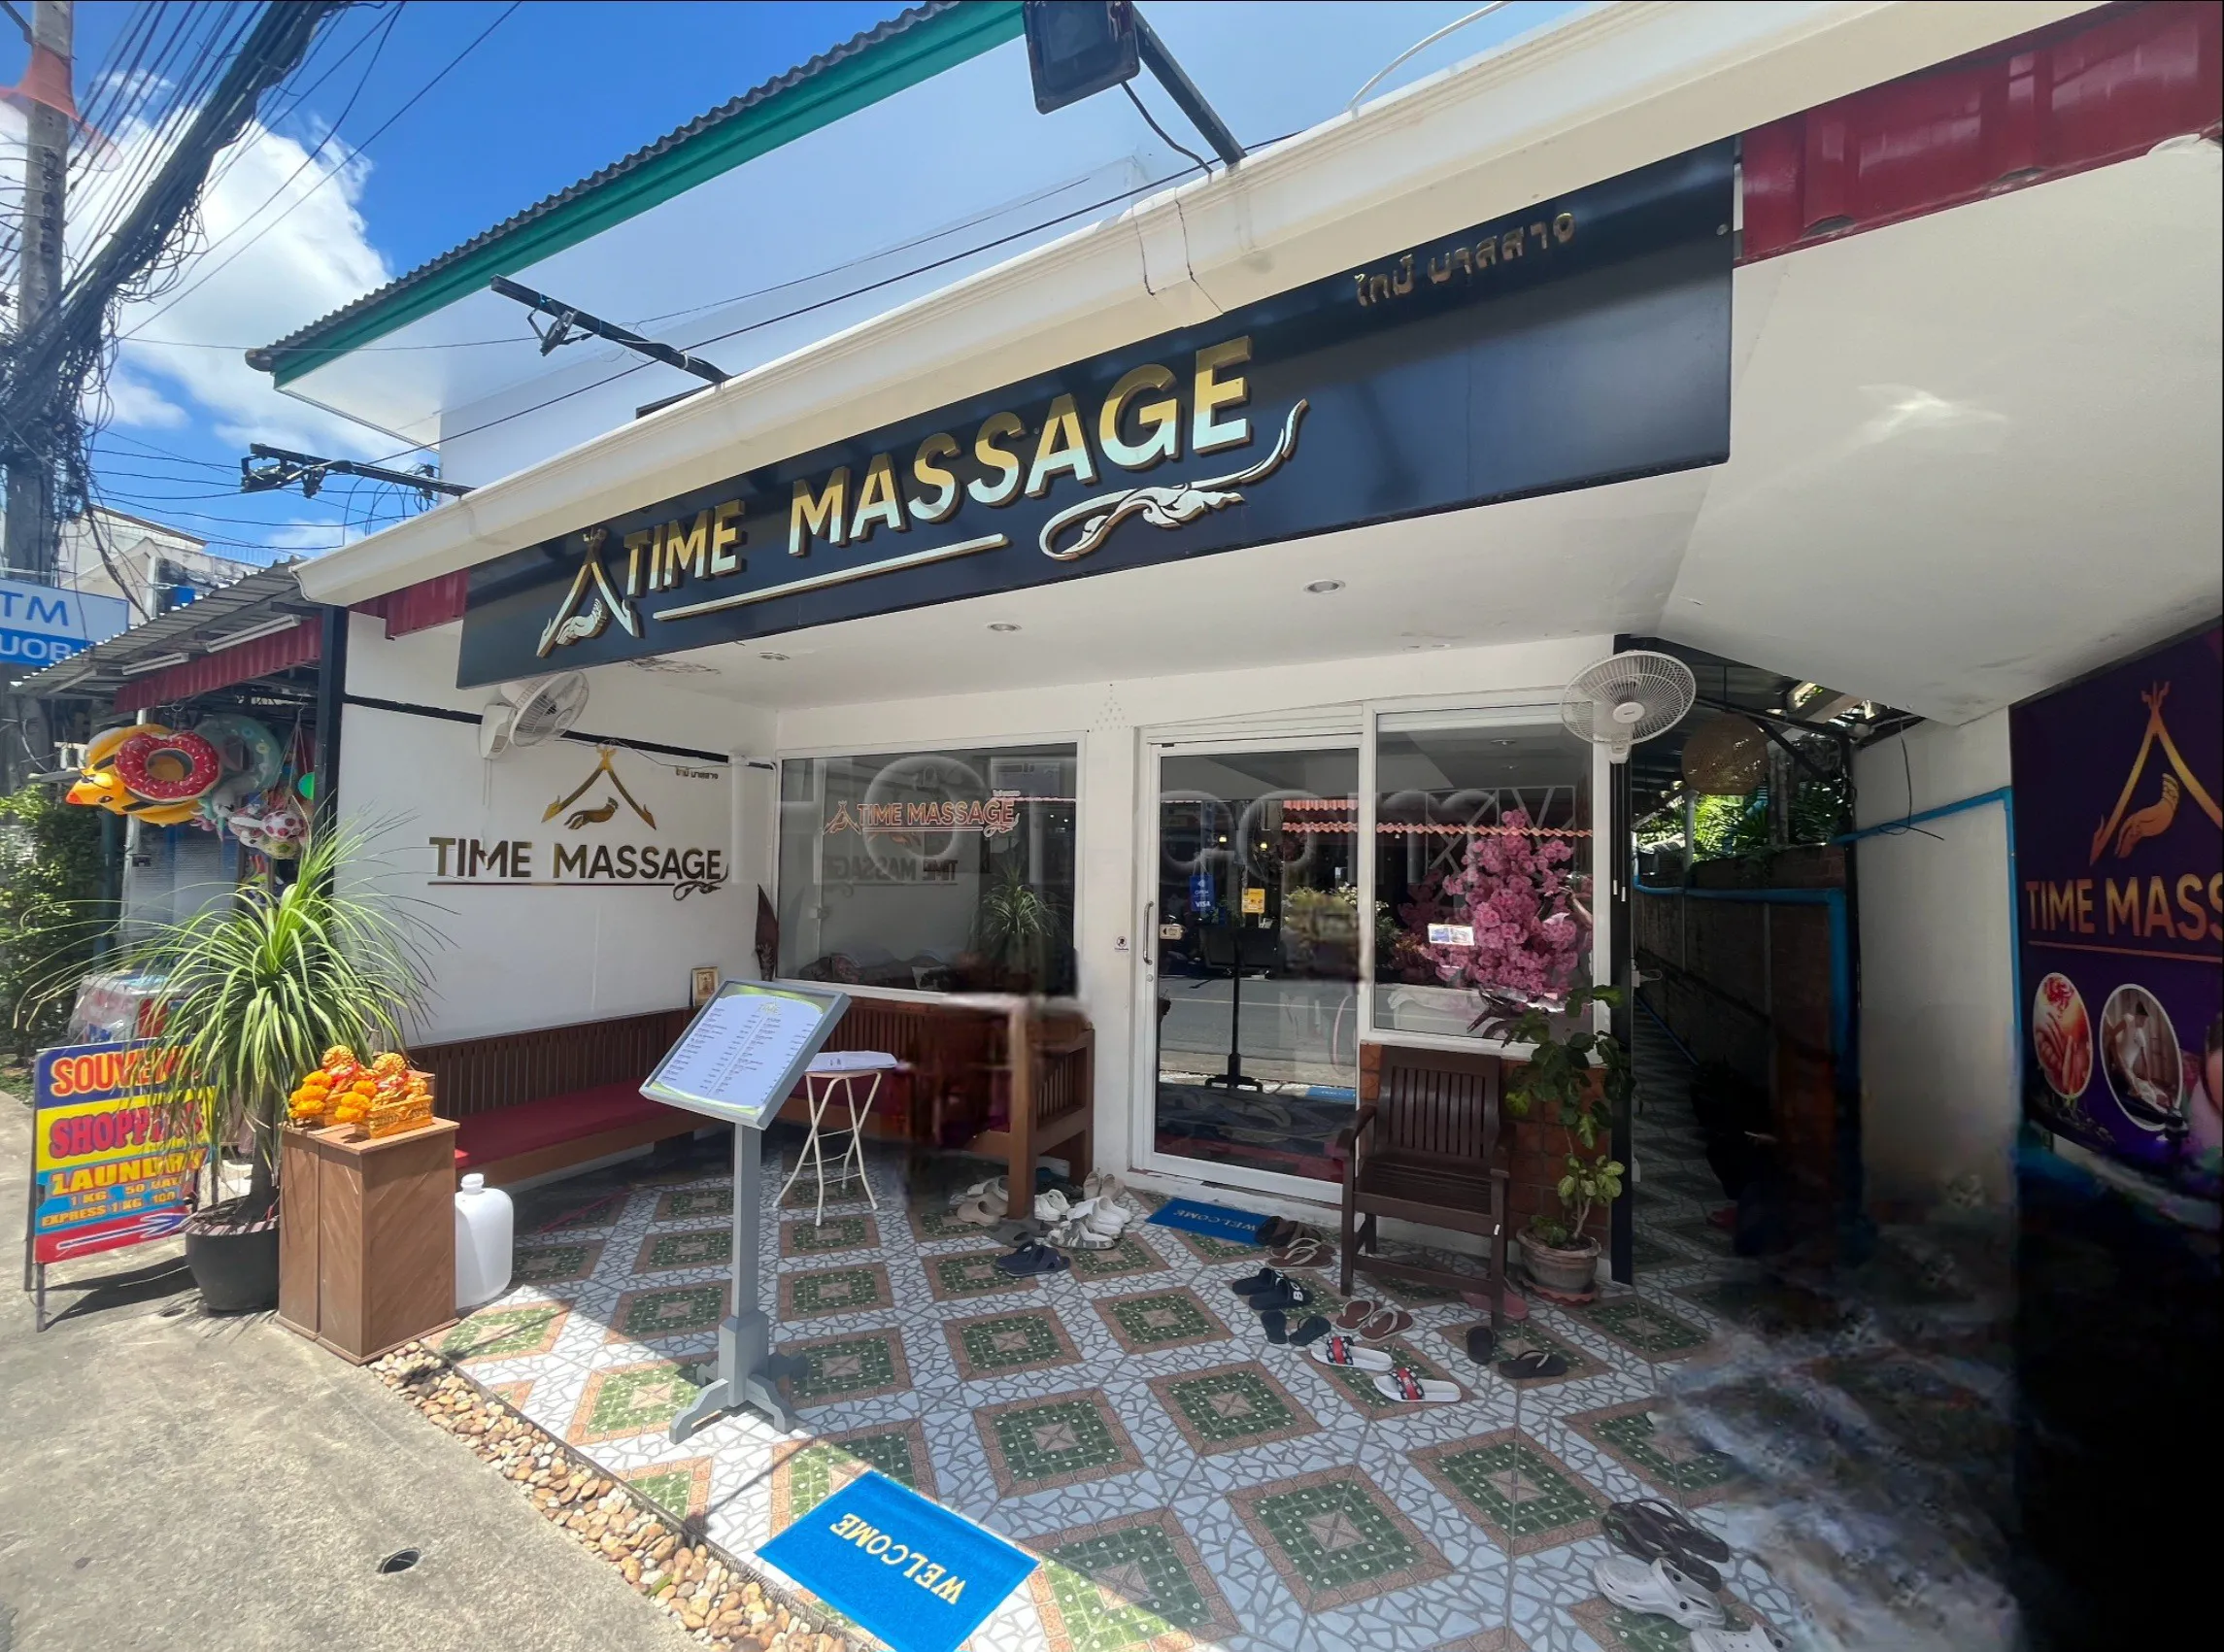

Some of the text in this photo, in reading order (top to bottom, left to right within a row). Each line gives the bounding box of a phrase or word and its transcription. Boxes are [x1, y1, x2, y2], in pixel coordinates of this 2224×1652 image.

[623, 335, 1252, 597] TIME MASSAGE
[0, 633, 72, 661] UOB
[857, 800, 1016, 826] TIME MASSAGE
[428, 836, 722, 880] TIME MASSAGE
[2026, 878, 2096, 934] TIME
[50, 1101, 204, 1160] SHOPPI
[83, 1191, 108, 1204] KG
[125, 1183, 145, 1195] 50
[41, 1204, 106, 1228] EXPRESS
[122, 1197, 143, 1211] KG
[1172, 1208, 1258, 1232] WELCOME
[828, 1512, 967, 1605] WELCOME
